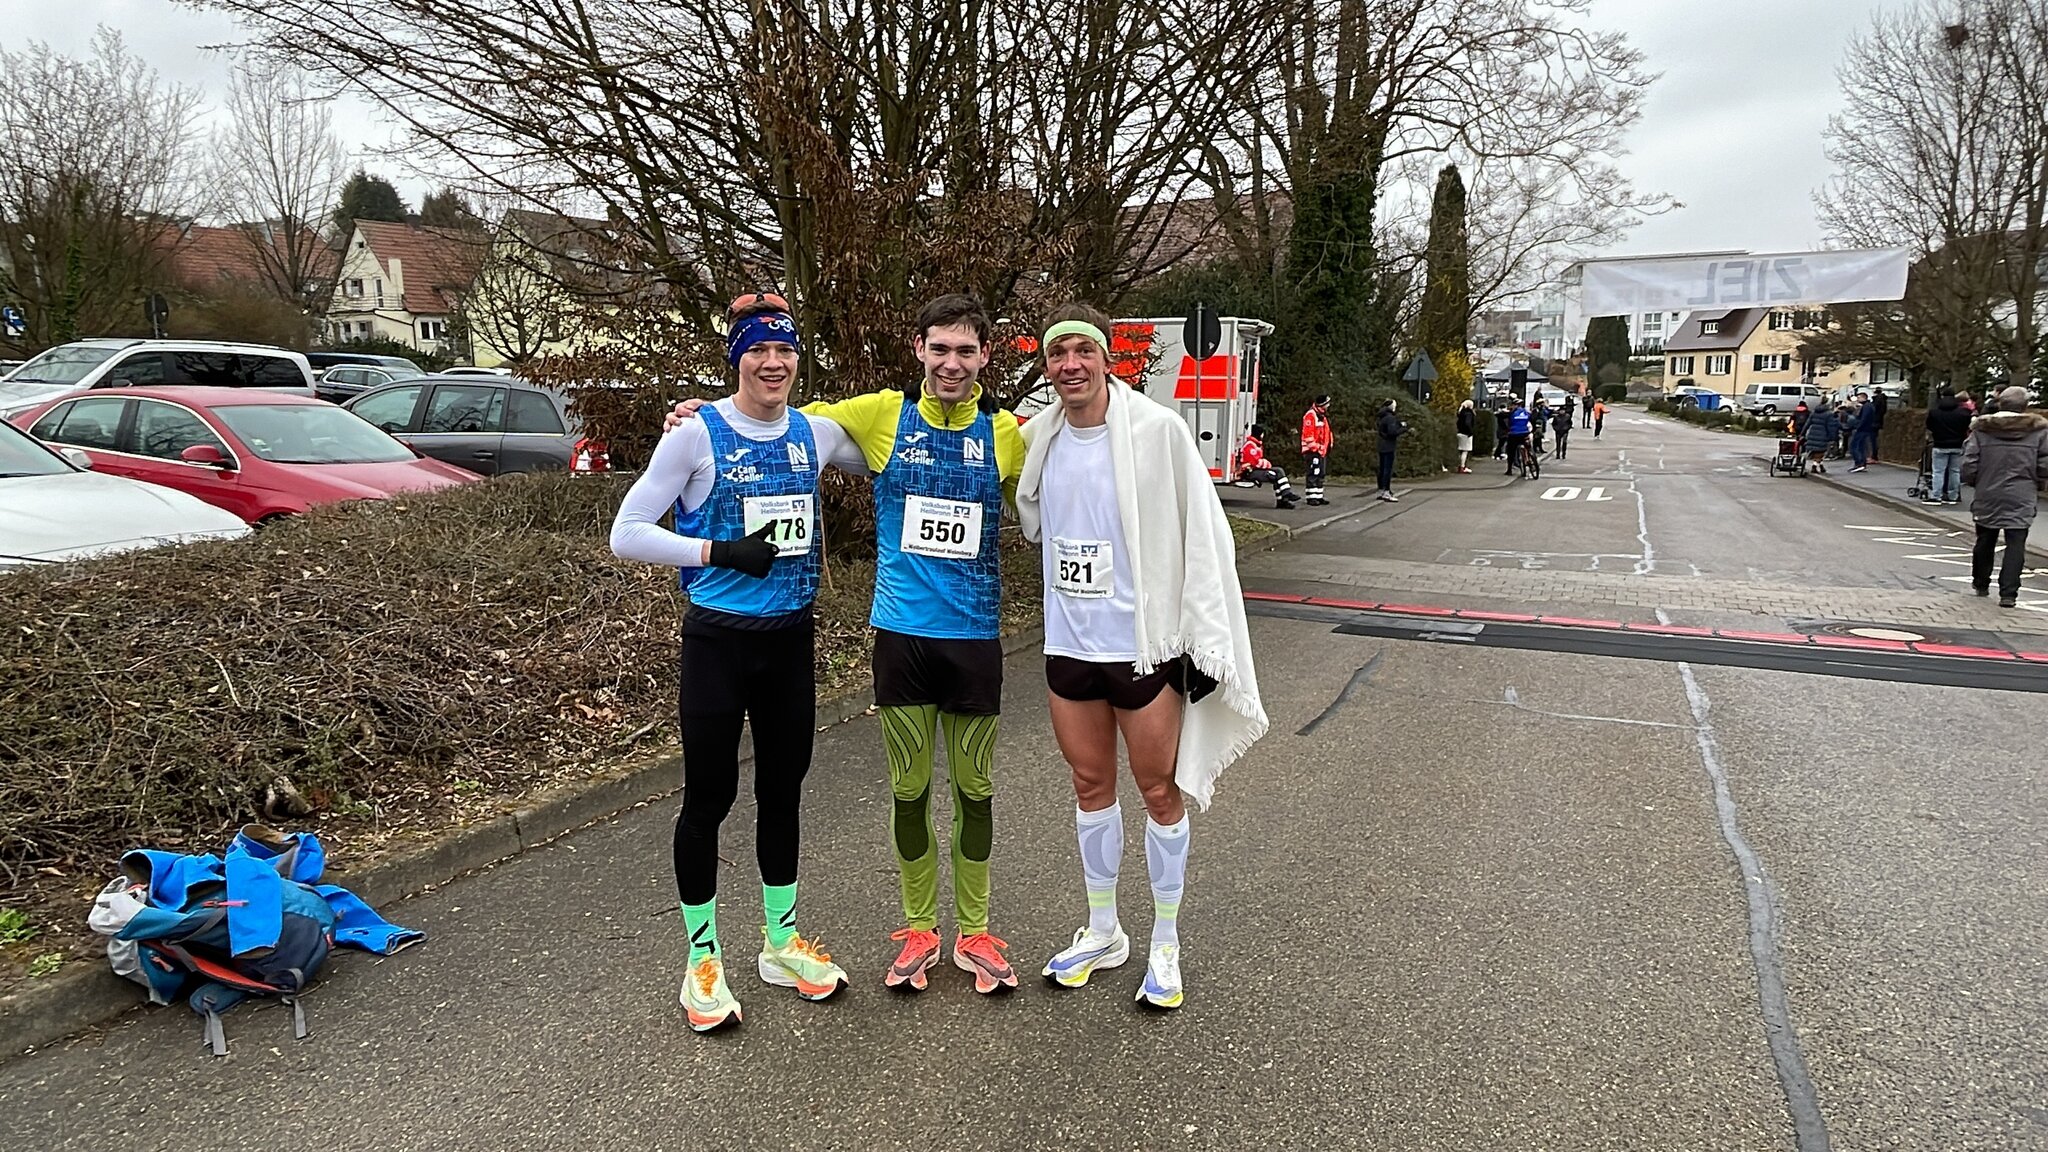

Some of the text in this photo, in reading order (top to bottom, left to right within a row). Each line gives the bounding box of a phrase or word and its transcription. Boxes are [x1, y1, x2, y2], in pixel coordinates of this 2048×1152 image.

[910, 447, 929, 457] Cam
[910, 456, 936, 466] Seller
[737, 465, 757, 474] Cam
[738, 473, 764, 483] Seller
[920, 500, 952, 511] Volksbank
[919, 507, 952, 517] Heilbronn
[919, 518, 966, 545] 550
[1060, 559, 1092, 584] 521
